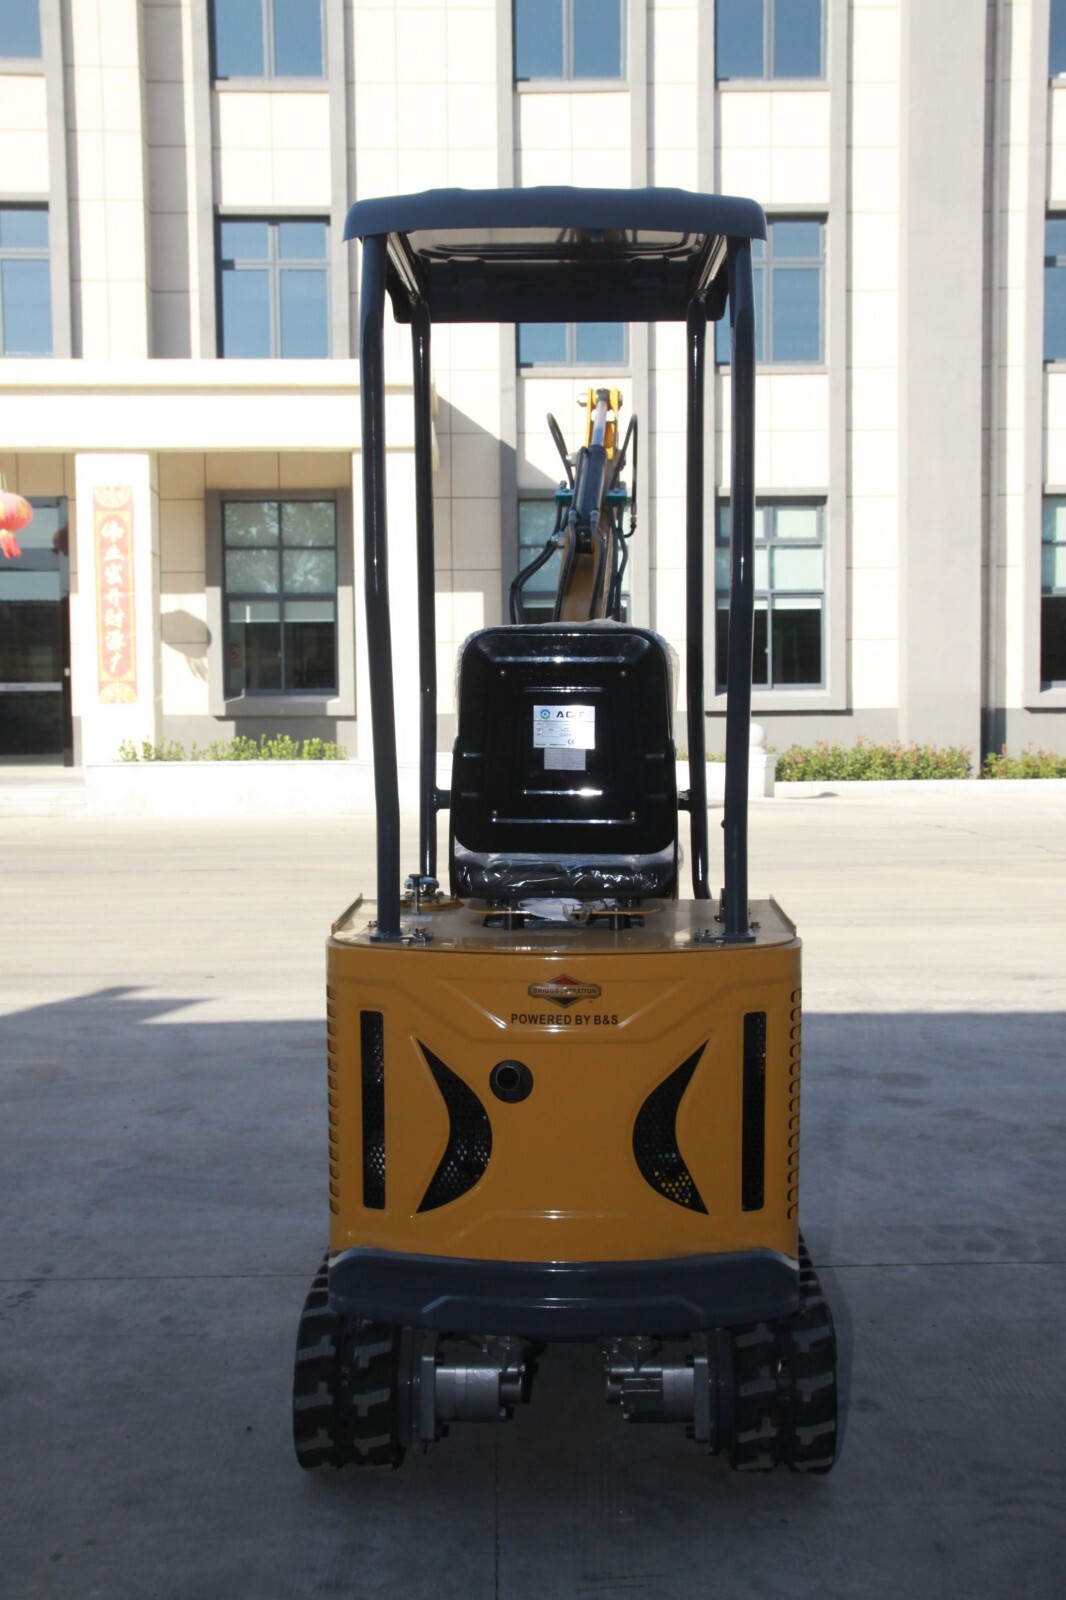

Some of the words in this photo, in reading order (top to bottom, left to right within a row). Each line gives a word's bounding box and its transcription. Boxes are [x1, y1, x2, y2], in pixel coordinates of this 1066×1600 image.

[511, 1013, 572, 1025] POWERED
[575, 1014, 591, 1025] BY
[594, 1014, 619, 1026] B&S
